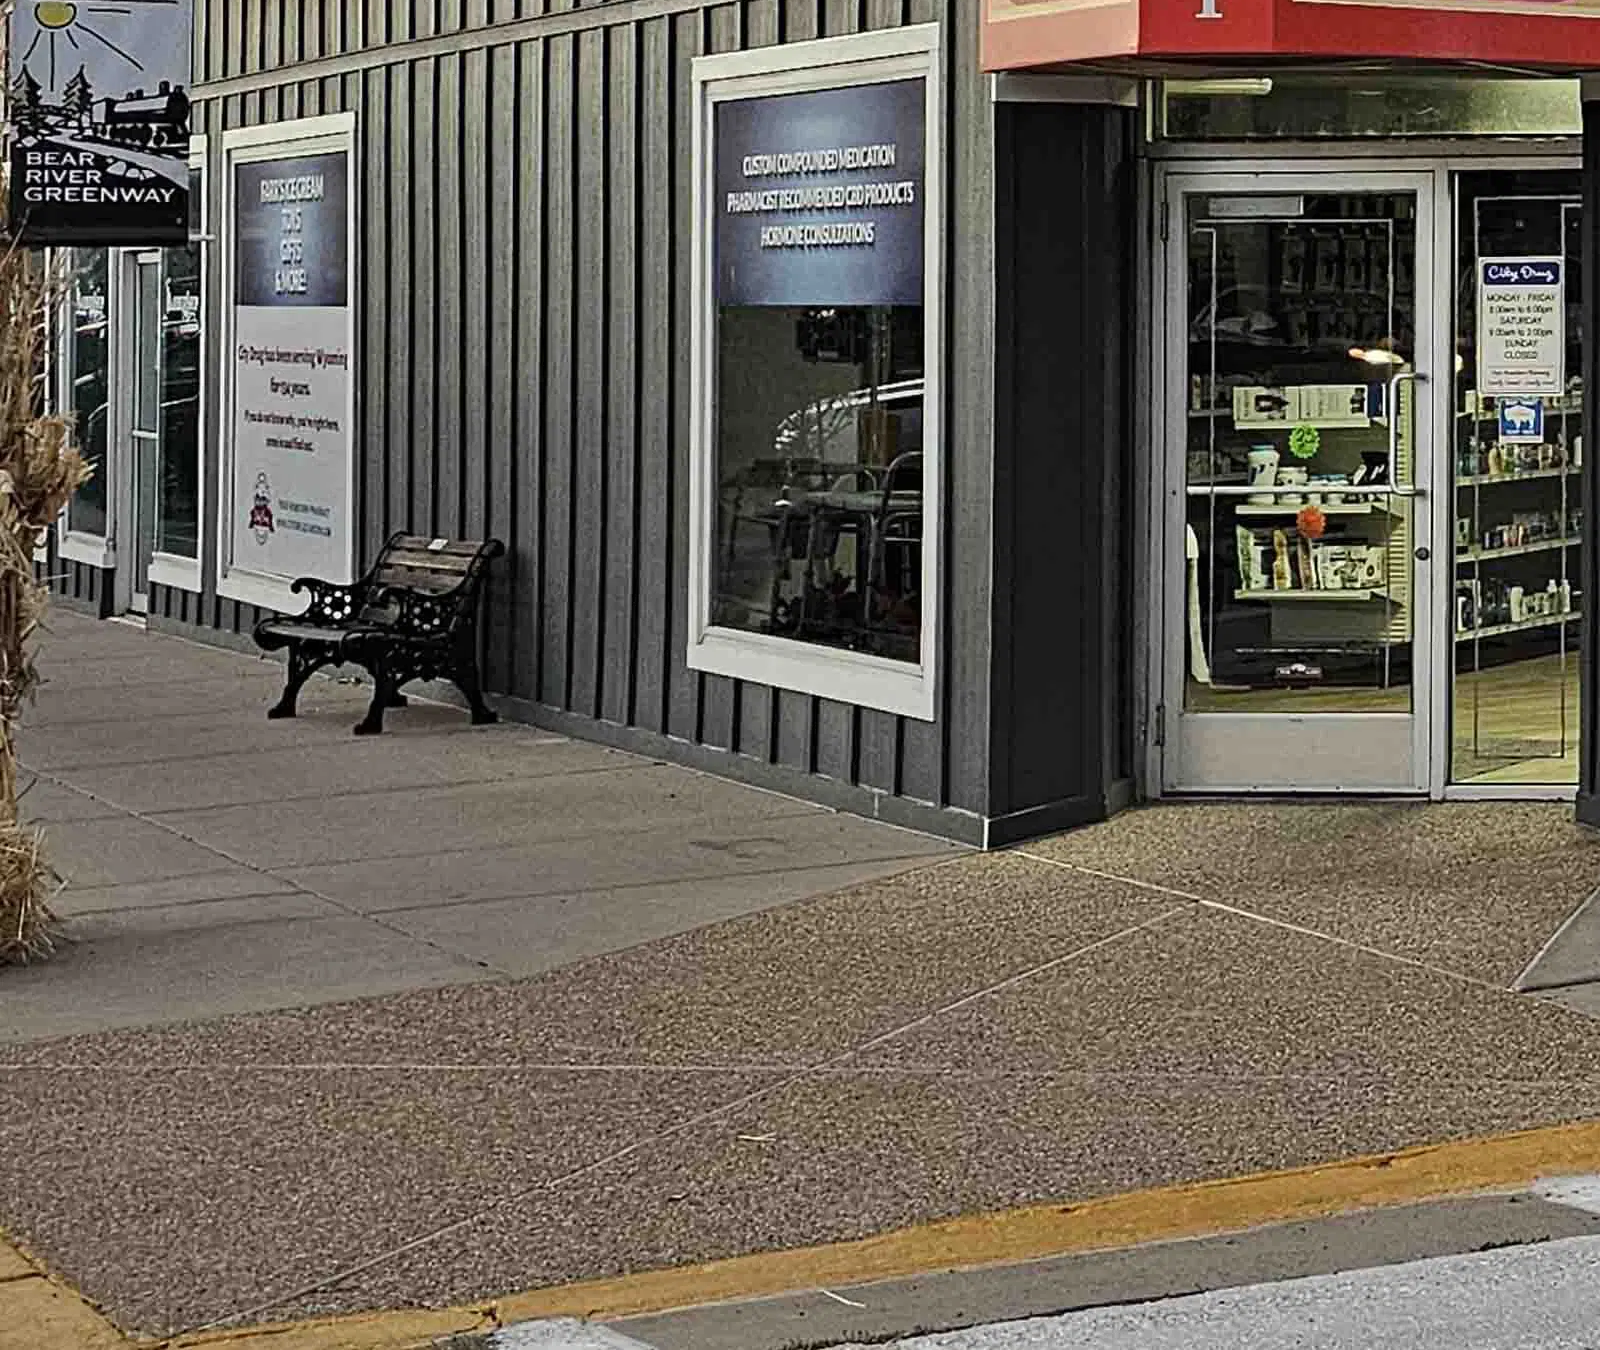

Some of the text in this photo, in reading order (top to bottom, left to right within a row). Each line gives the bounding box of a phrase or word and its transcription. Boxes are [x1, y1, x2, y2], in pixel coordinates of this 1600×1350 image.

[26, 151, 96, 166] BEAR
[742, 144, 896, 177] CUSTOM COMPOUNDED MEDICATION
[25, 169, 102, 185] RIVER
[24, 186, 176, 203] GREENWAY
[727, 188, 779, 213] PHARMACIST
[779, 186, 846, 210] RECOMMENDED
[865, 181, 915, 205] PRODUCTS
[760, 221, 875, 247] HORMONE CONSULTATIONS
[1487, 265, 1555, 283] City Drug
